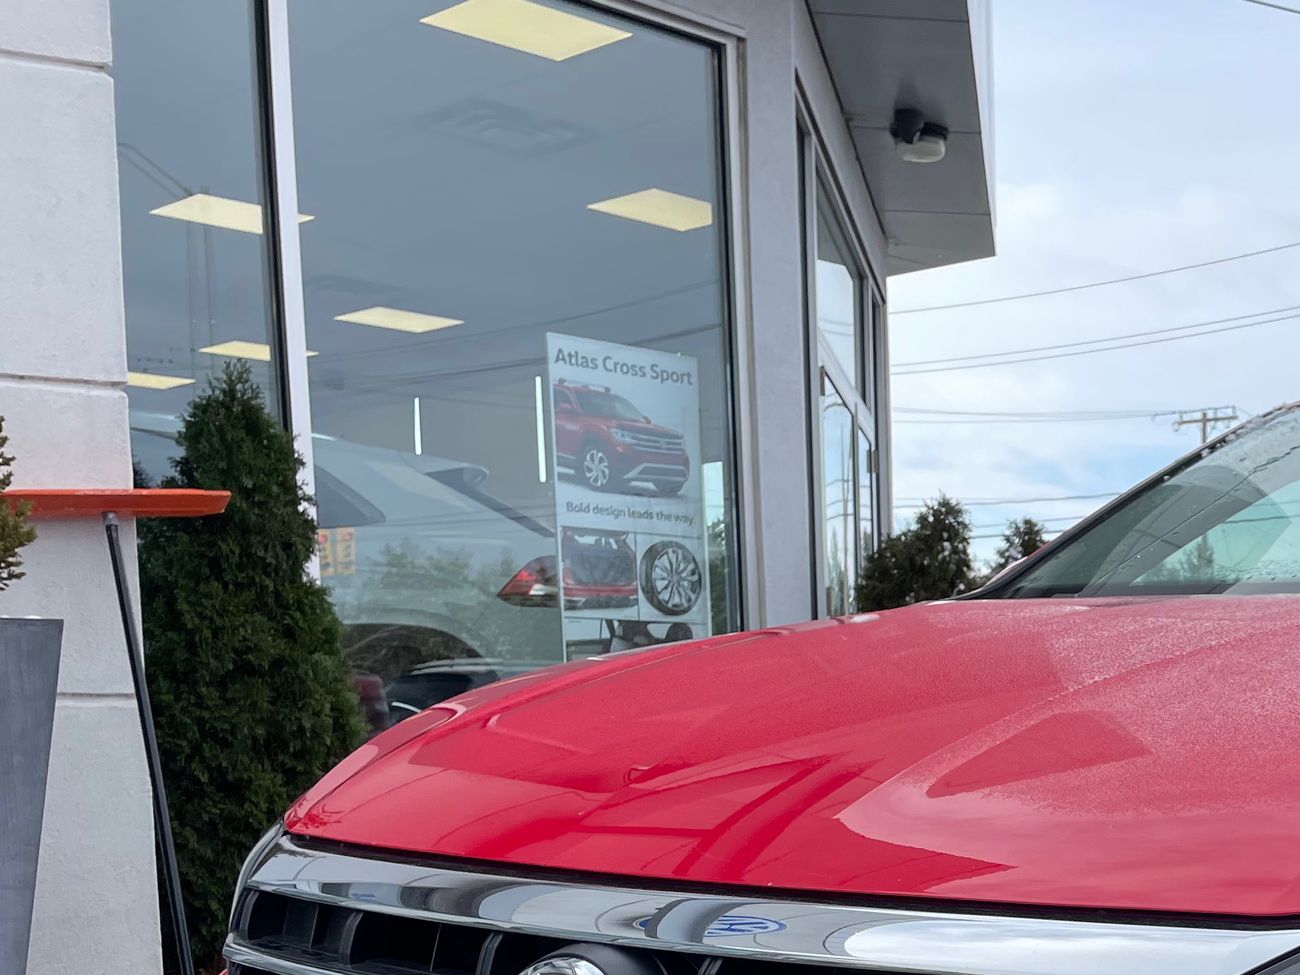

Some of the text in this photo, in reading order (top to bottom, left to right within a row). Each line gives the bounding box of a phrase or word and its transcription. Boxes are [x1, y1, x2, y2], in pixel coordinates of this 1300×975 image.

[554, 348, 694, 386] Atlas Cross Sport
[566, 501, 590, 514] Bold
[592, 505, 626, 519] design
[627, 508, 654, 521] leads
[656, 510, 673, 522] the
